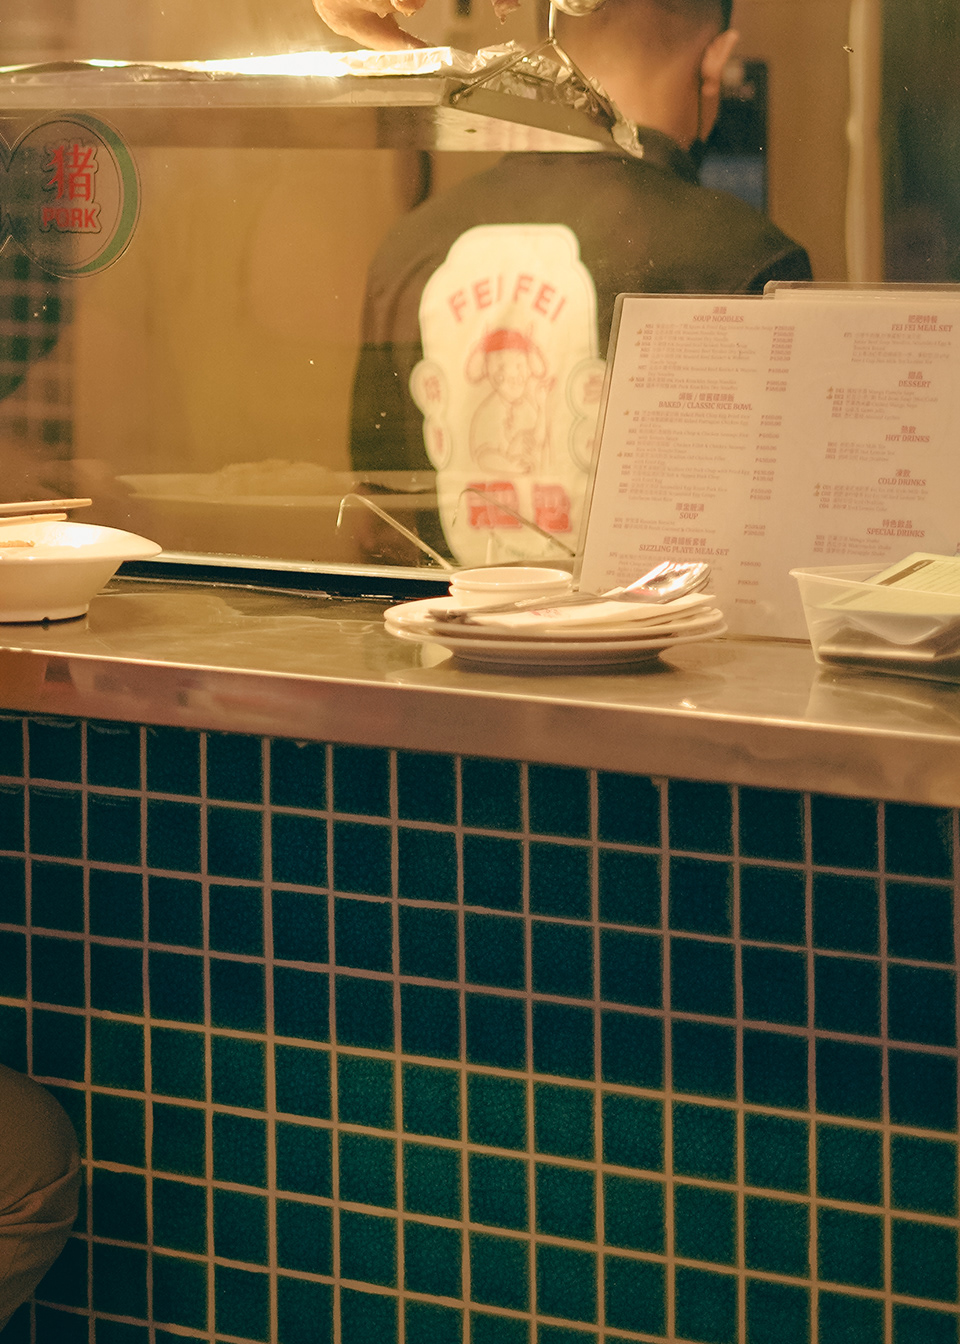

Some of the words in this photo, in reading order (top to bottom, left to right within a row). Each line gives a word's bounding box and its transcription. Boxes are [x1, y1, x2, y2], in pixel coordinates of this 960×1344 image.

[47, 143, 95, 201] 猪
[42, 207, 97, 229] PORK
[447, 275, 503, 323] FEI
[512, 273, 567, 323] FEI
[712, 315, 744, 323] NOODLES
[898, 380, 931, 389] DESSERT
[658, 401, 681, 409] BAKED
[687, 402, 715, 410] CLASSIC
[733, 403, 752, 411] BOWL
[885, 434, 901, 442] HOT
[902, 435, 930, 443] DRINKS
[877, 477, 897, 486] COLD
[898, 478, 927, 487] DRINKS
[679, 512, 699, 520] SOUP
[866, 528, 895, 536] SPECIAL
[897, 529, 926, 538] DRINKS
[639, 544, 671, 553] SIZZLING
[672, 545, 694, 554] PLATE
[695, 547, 715, 555] MEAL
[716, 548, 730, 556] SET
